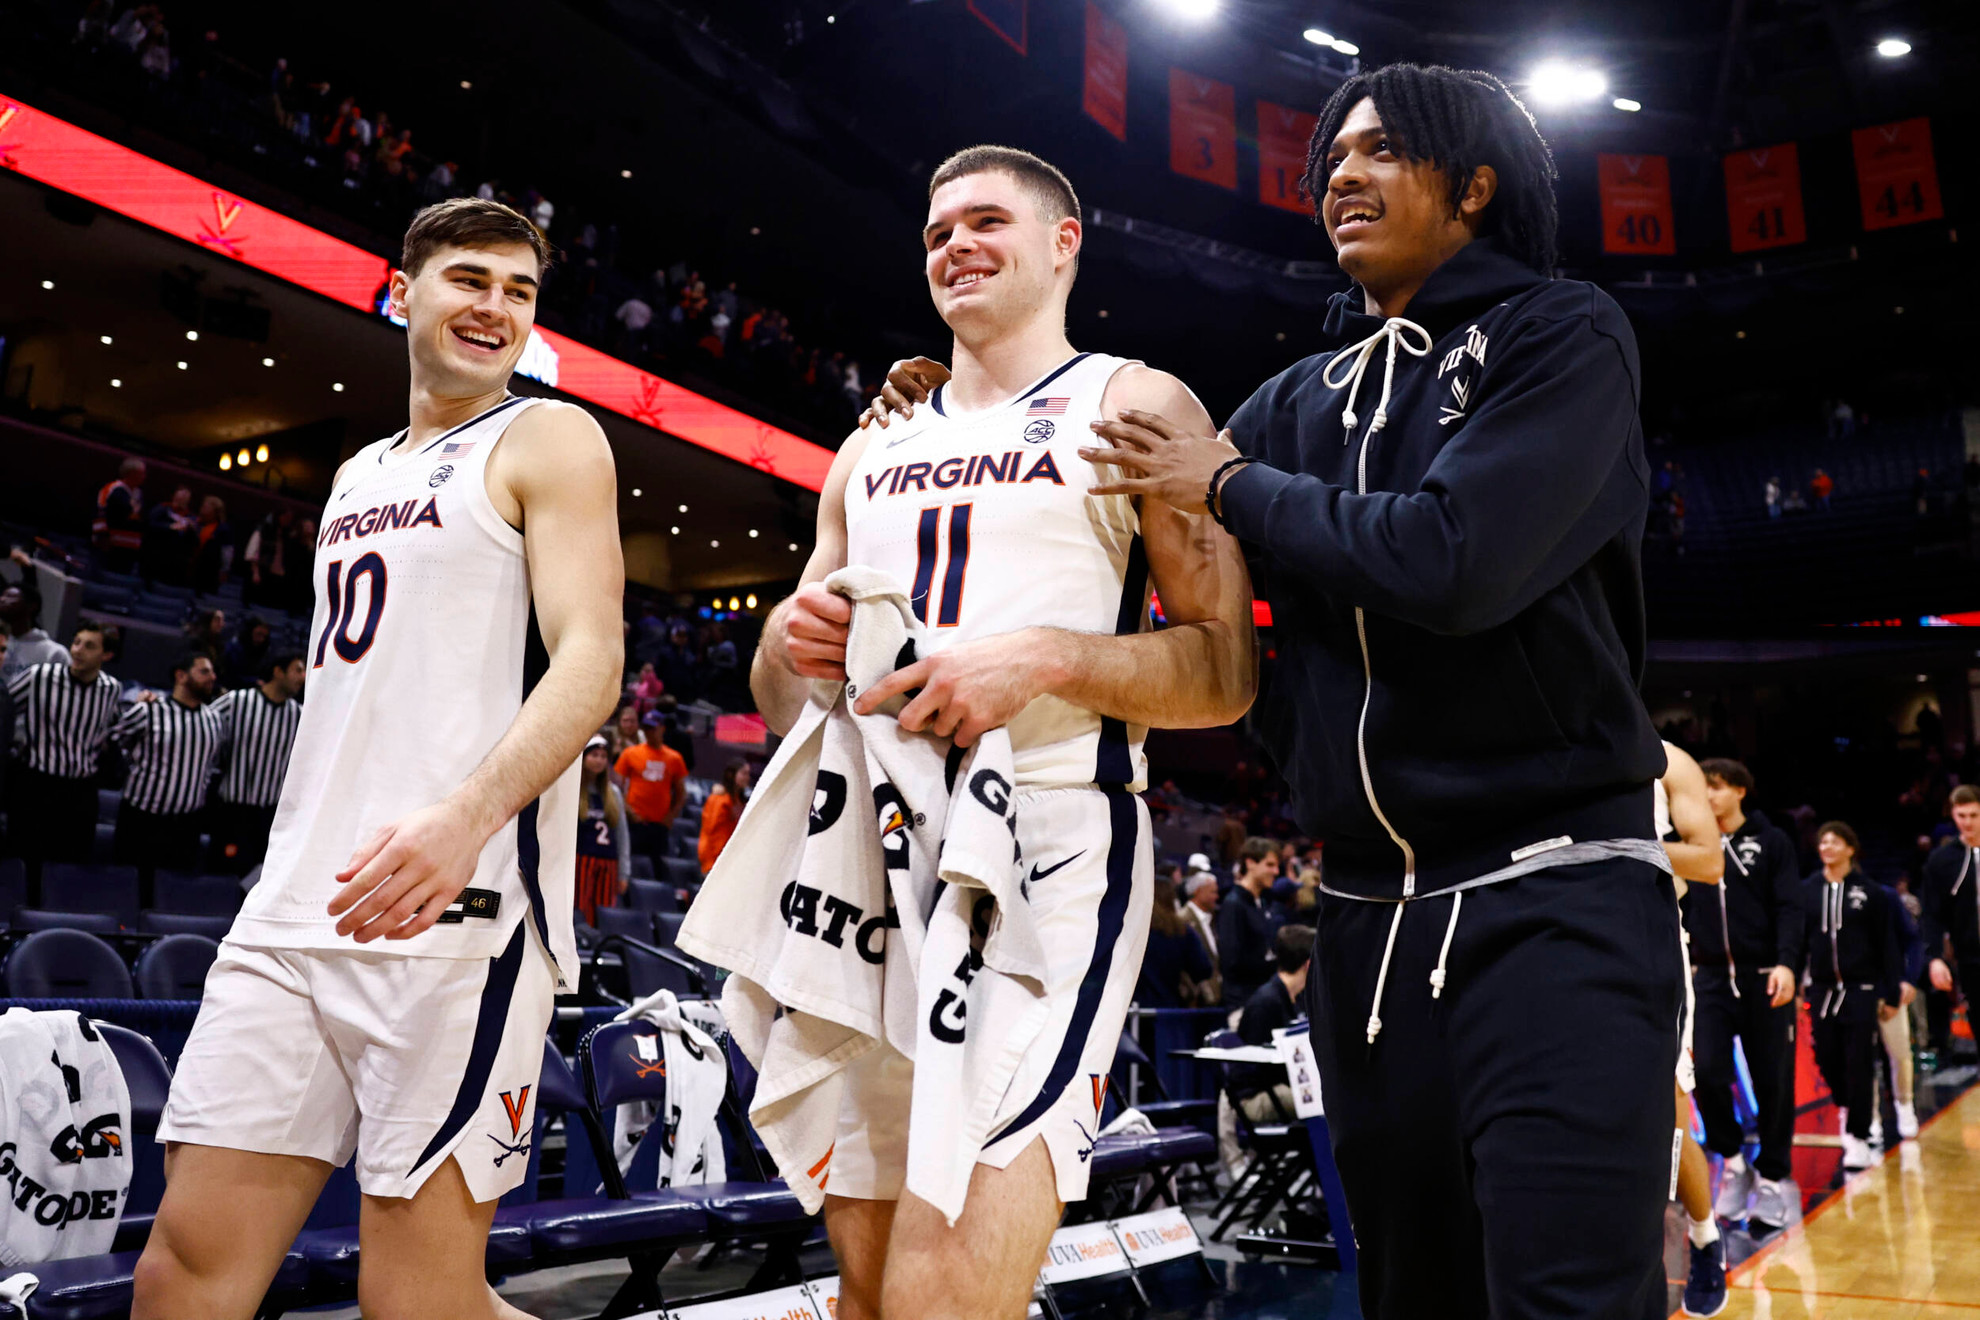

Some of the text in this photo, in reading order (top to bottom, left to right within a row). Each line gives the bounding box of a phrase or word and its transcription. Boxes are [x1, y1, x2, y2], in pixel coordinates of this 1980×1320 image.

[1196, 136, 1214, 170] 3
[1875, 181, 1925, 218] 44
[1616, 213, 1662, 246] 40
[1748, 207, 1787, 240] 41
[865, 450, 1066, 502] VIRGINIA
[319, 495, 443, 549] VIRGINIA
[911, 502, 973, 628] 11
[313, 551, 388, 669] 10
[595, 820, 611, 846] 2
[471, 897, 487, 909] 46
